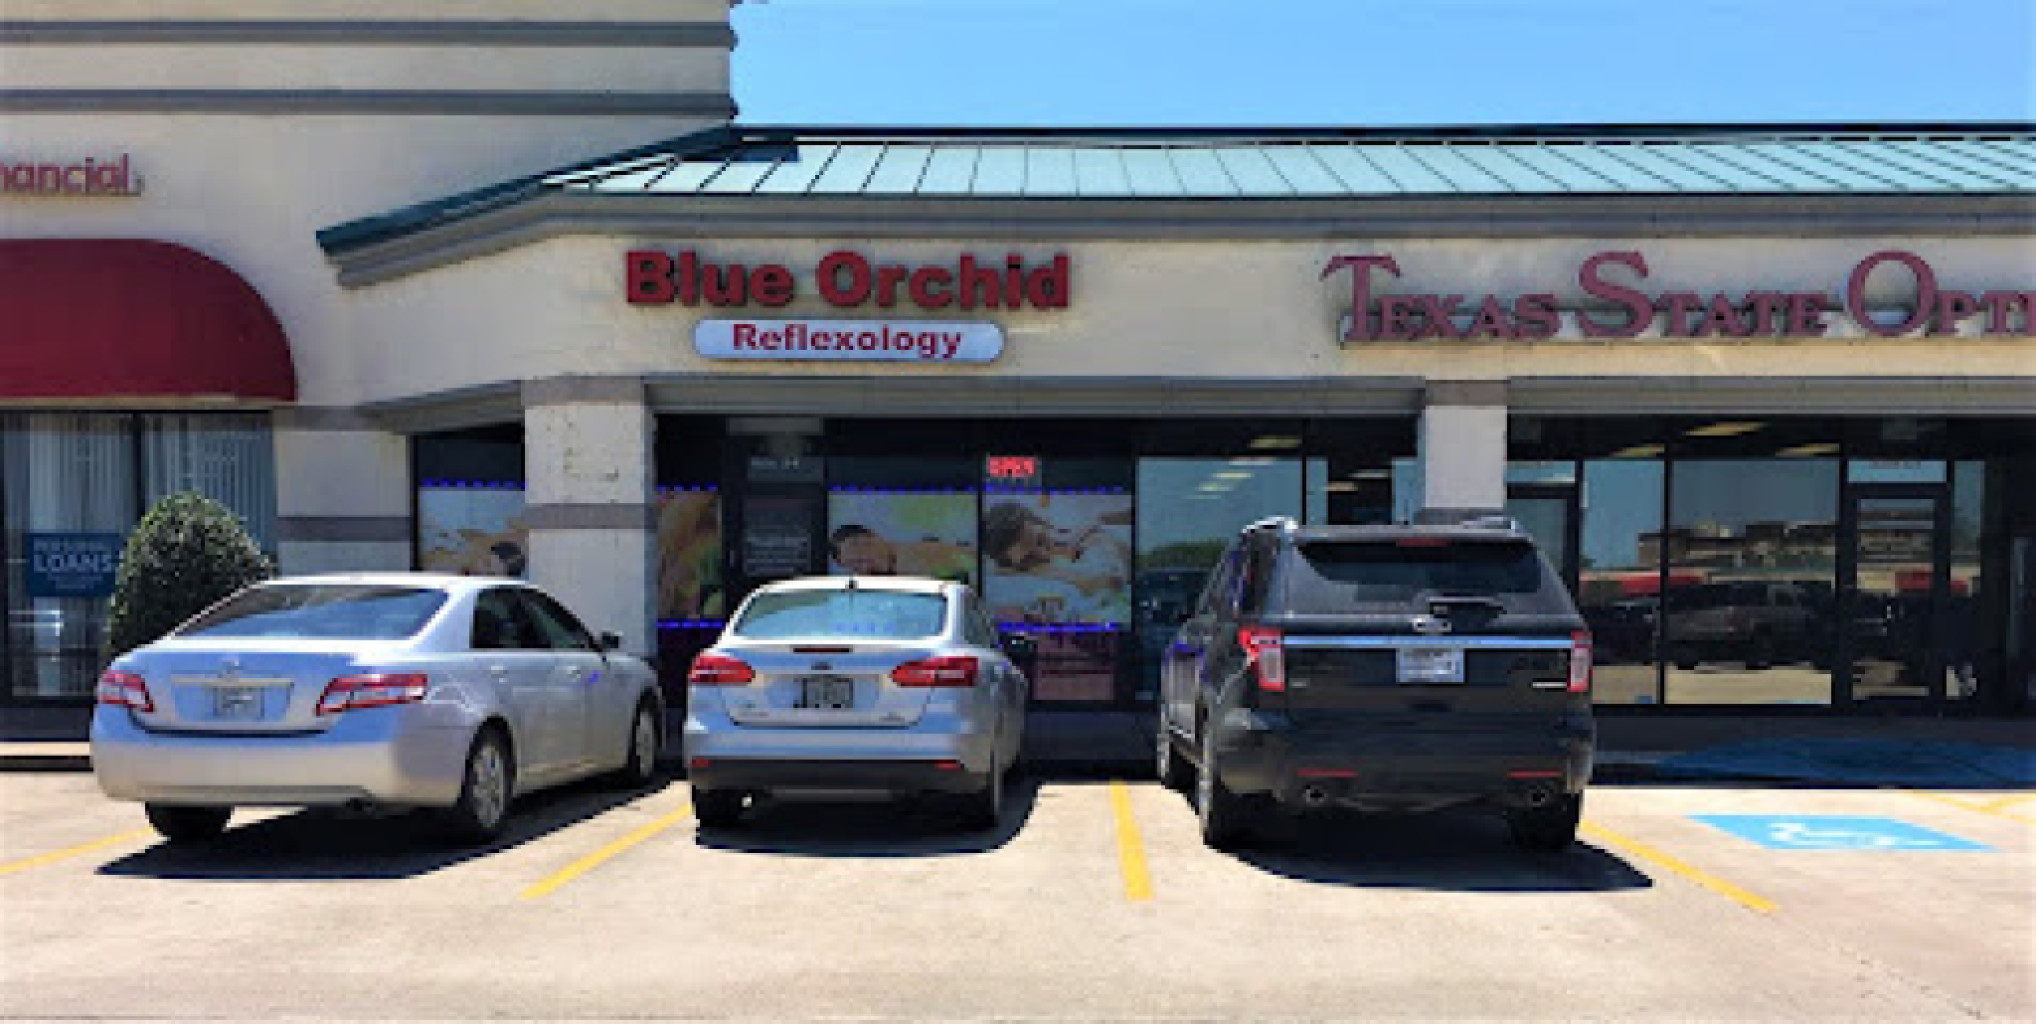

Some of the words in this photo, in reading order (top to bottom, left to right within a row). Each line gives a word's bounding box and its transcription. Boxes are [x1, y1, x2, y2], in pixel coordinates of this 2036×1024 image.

[626, 251, 795, 305] Blue
[816, 251, 1069, 309] Orchid
[1320, 254, 1563, 341] TEXAS
[1577, 251, 1828, 338] STATE
[732, 324, 962, 358] Reflexology
[33, 554, 113, 573] LOANS
